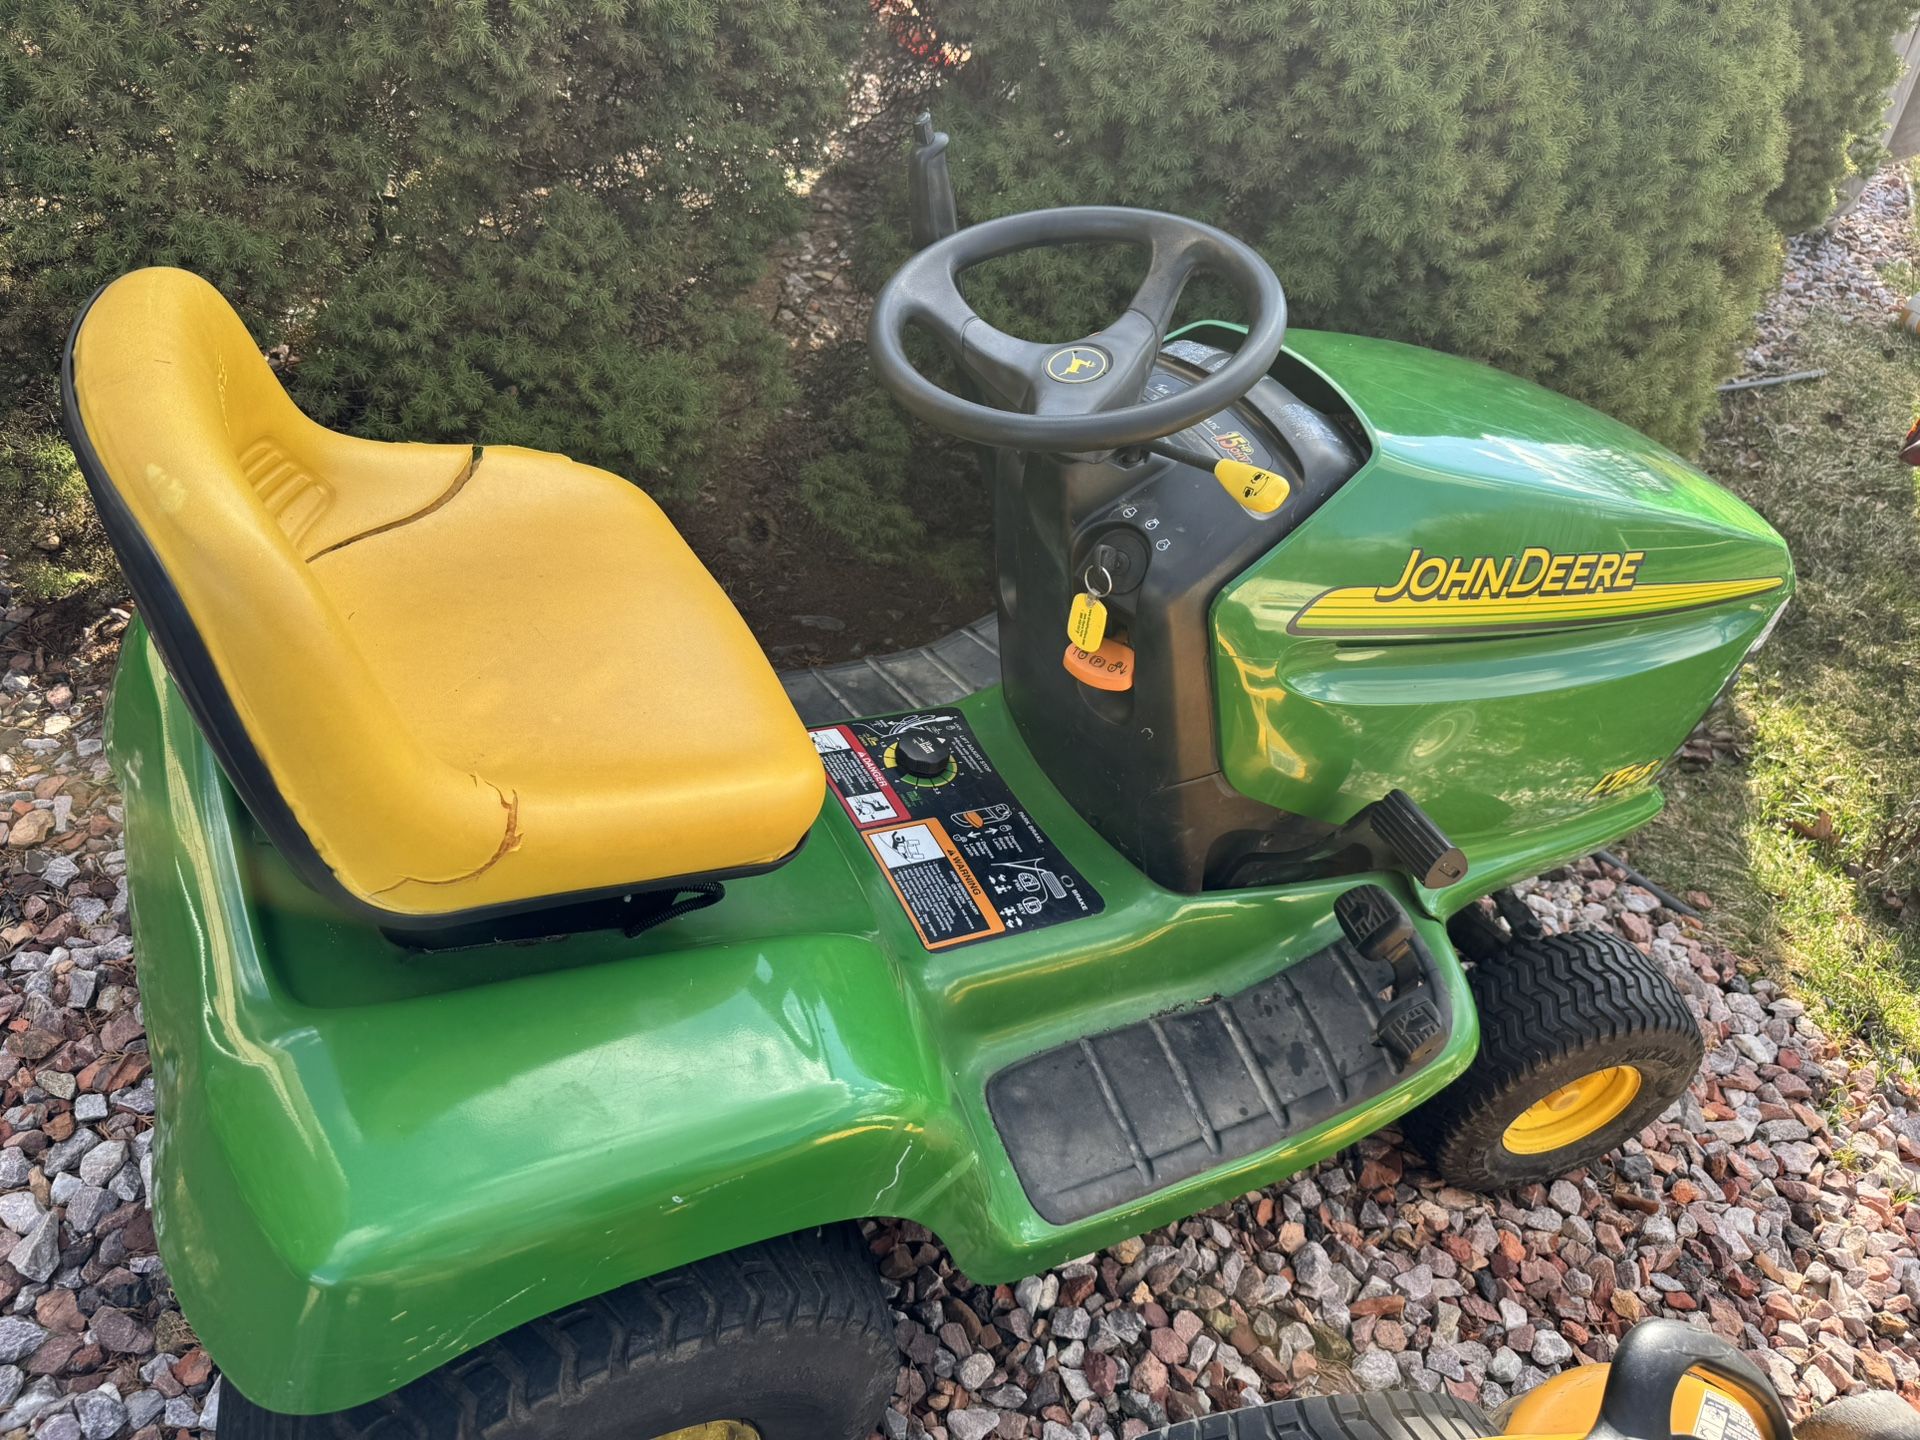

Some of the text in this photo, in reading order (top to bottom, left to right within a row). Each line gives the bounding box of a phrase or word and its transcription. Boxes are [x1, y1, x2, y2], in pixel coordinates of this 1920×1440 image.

[1214, 432, 1246, 449] 15
[1375, 547, 1644, 602] JOHN DEERE
[862, 757, 887, 786] DANGER
[1018, 810, 1043, 844] PARK BRAKE
[952, 856, 980, 895] WARNING
[1071, 888, 1089, 911] BRAKE
